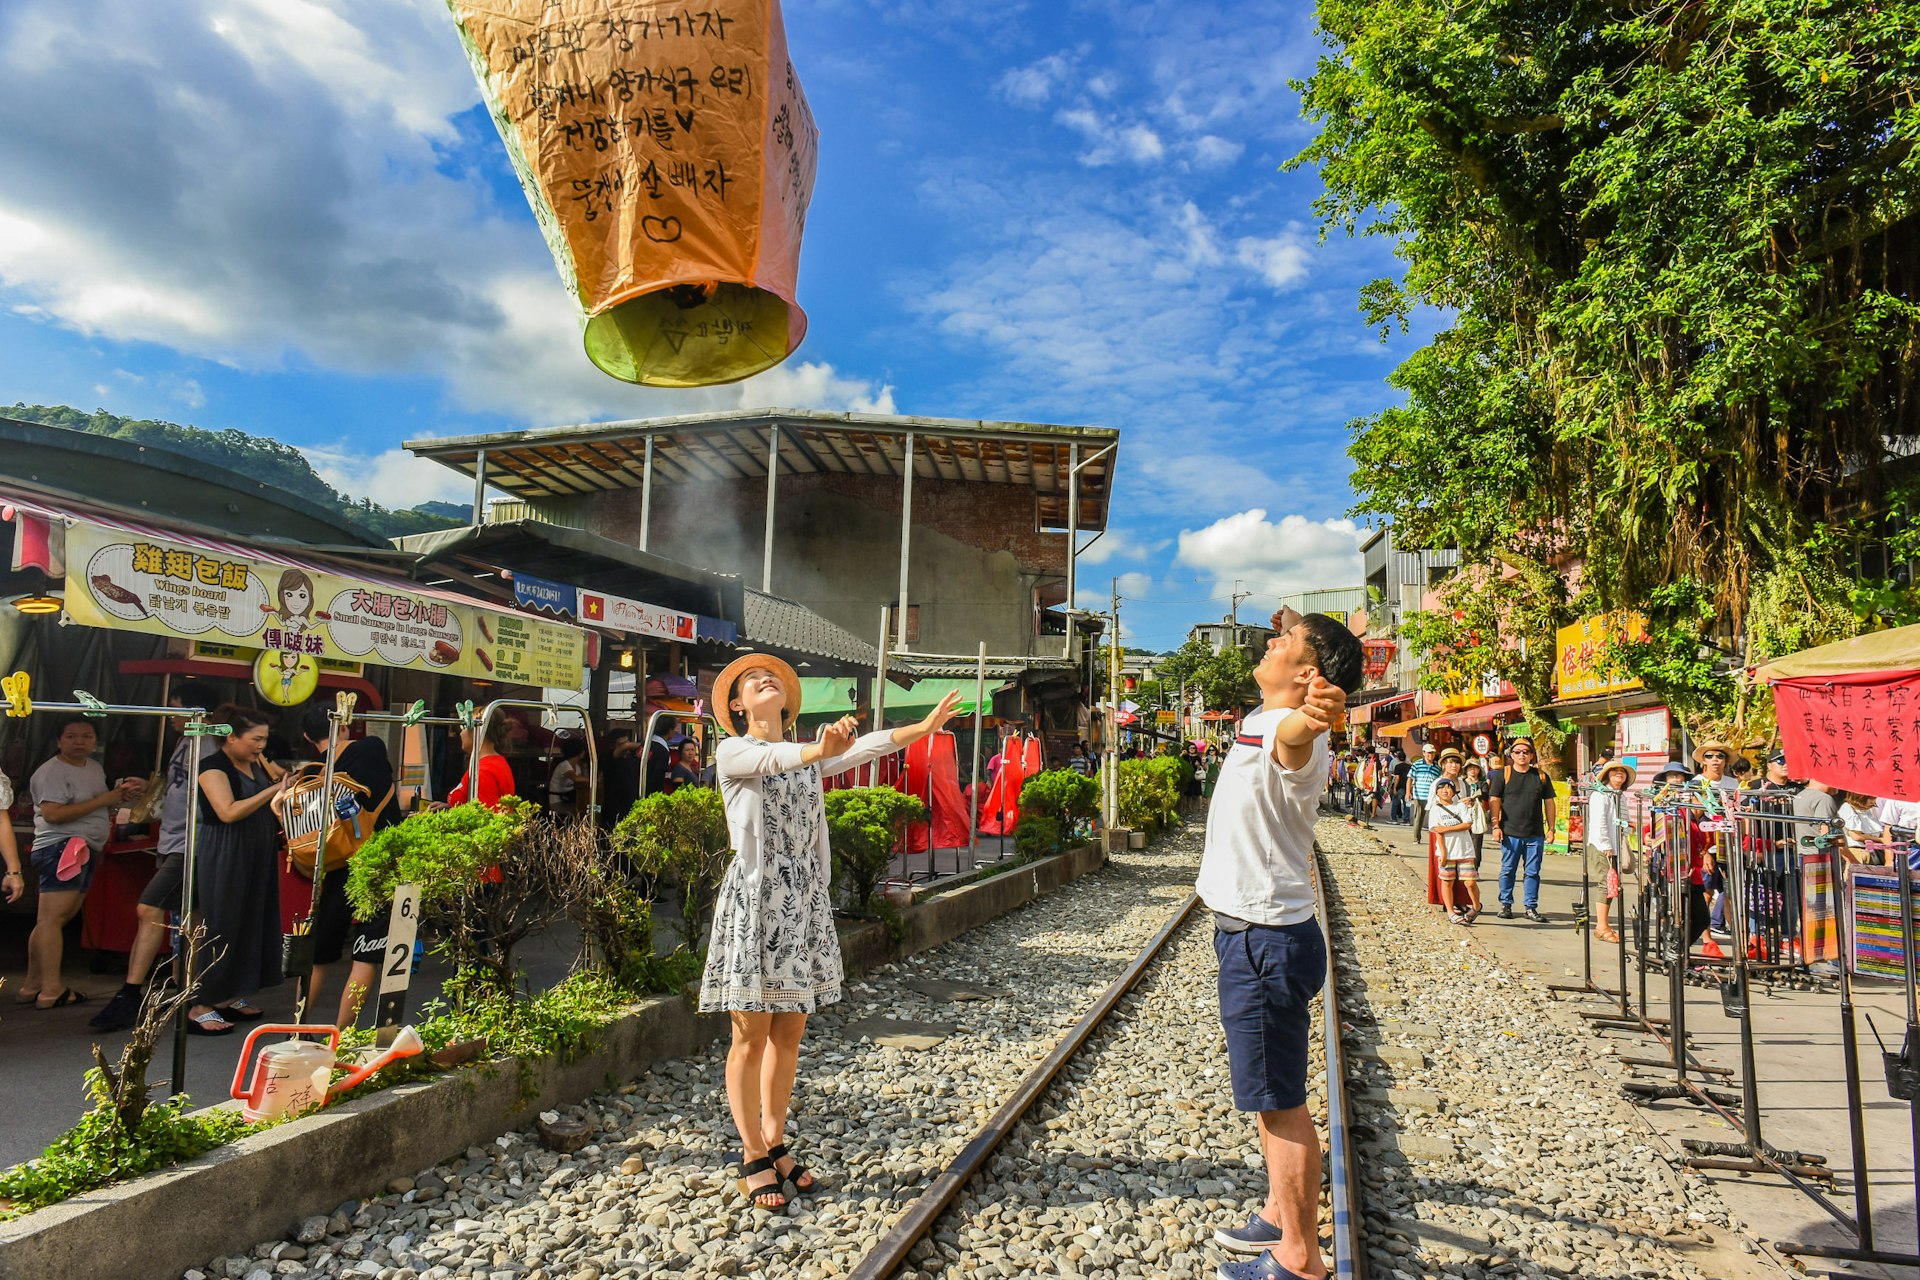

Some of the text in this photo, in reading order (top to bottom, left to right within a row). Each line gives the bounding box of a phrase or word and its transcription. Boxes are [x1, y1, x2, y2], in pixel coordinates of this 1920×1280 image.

[600, 8, 734, 52] 장가가자
[709, 63, 752, 101] 우리
[132, 543, 248, 591] 雞翅包飯
[149, 594, 231, 619] 닭날개 볶음밥
[192, 586, 227, 601] board
[350, 588, 448, 628] 大腸包小腸
[333, 611, 360, 625] Small
[361, 616, 395, 632] Sausage
[405, 624, 428, 637] Large
[428, 628, 459, 642] Sausage
[370, 632, 426, 649] 대만식 핫도그
[656, 613, 675, 634] 天鼎
[1841, 686, 1859, 778] 百香果
[1862, 688, 1878, 773] 冬瓜茶
[401, 897, 412, 918] 6
[386, 943, 410, 977] 2
